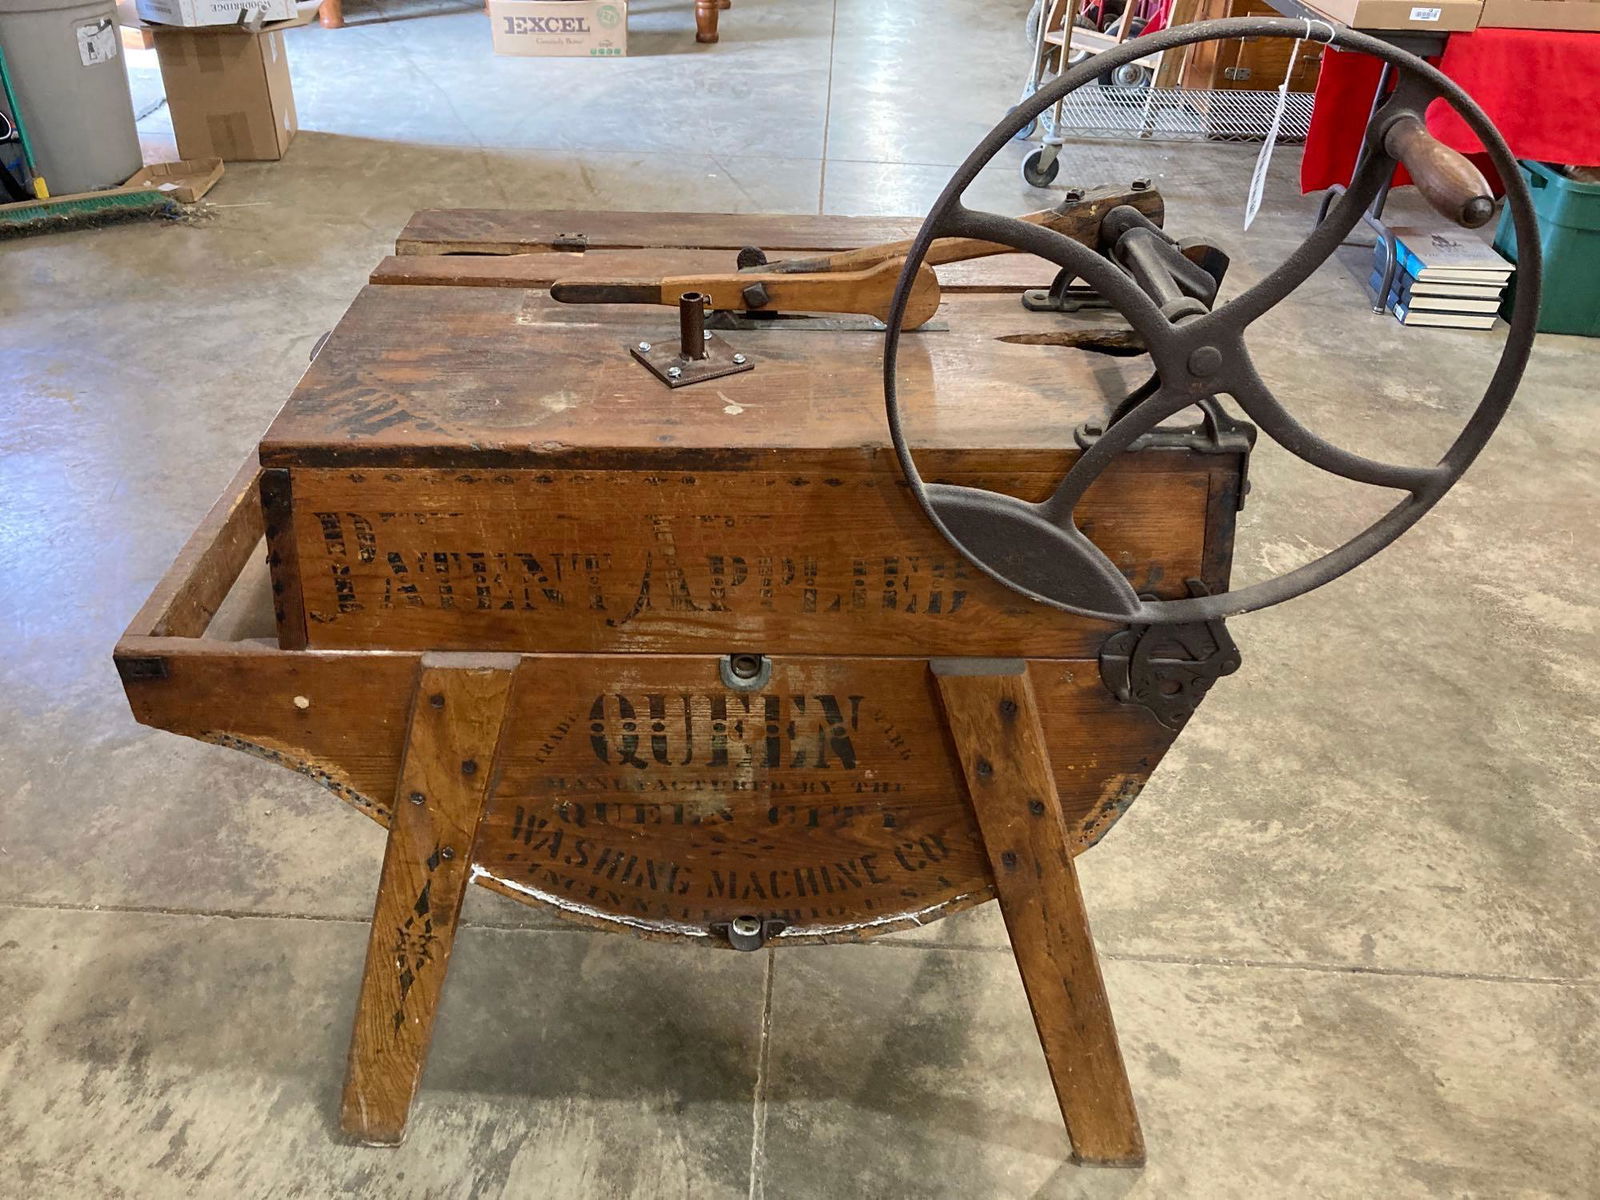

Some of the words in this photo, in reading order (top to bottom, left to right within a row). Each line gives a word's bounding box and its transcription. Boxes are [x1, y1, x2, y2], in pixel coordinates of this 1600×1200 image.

[503, 16, 591, 34] EXCEL
[310, 512, 612, 623] PATENT
[606, 514, 967, 627] APPLIED
[589, 693, 865, 770] QUEEN
[511, 805, 691, 895] WASHING
[706, 853, 891, 900] MACHINE
